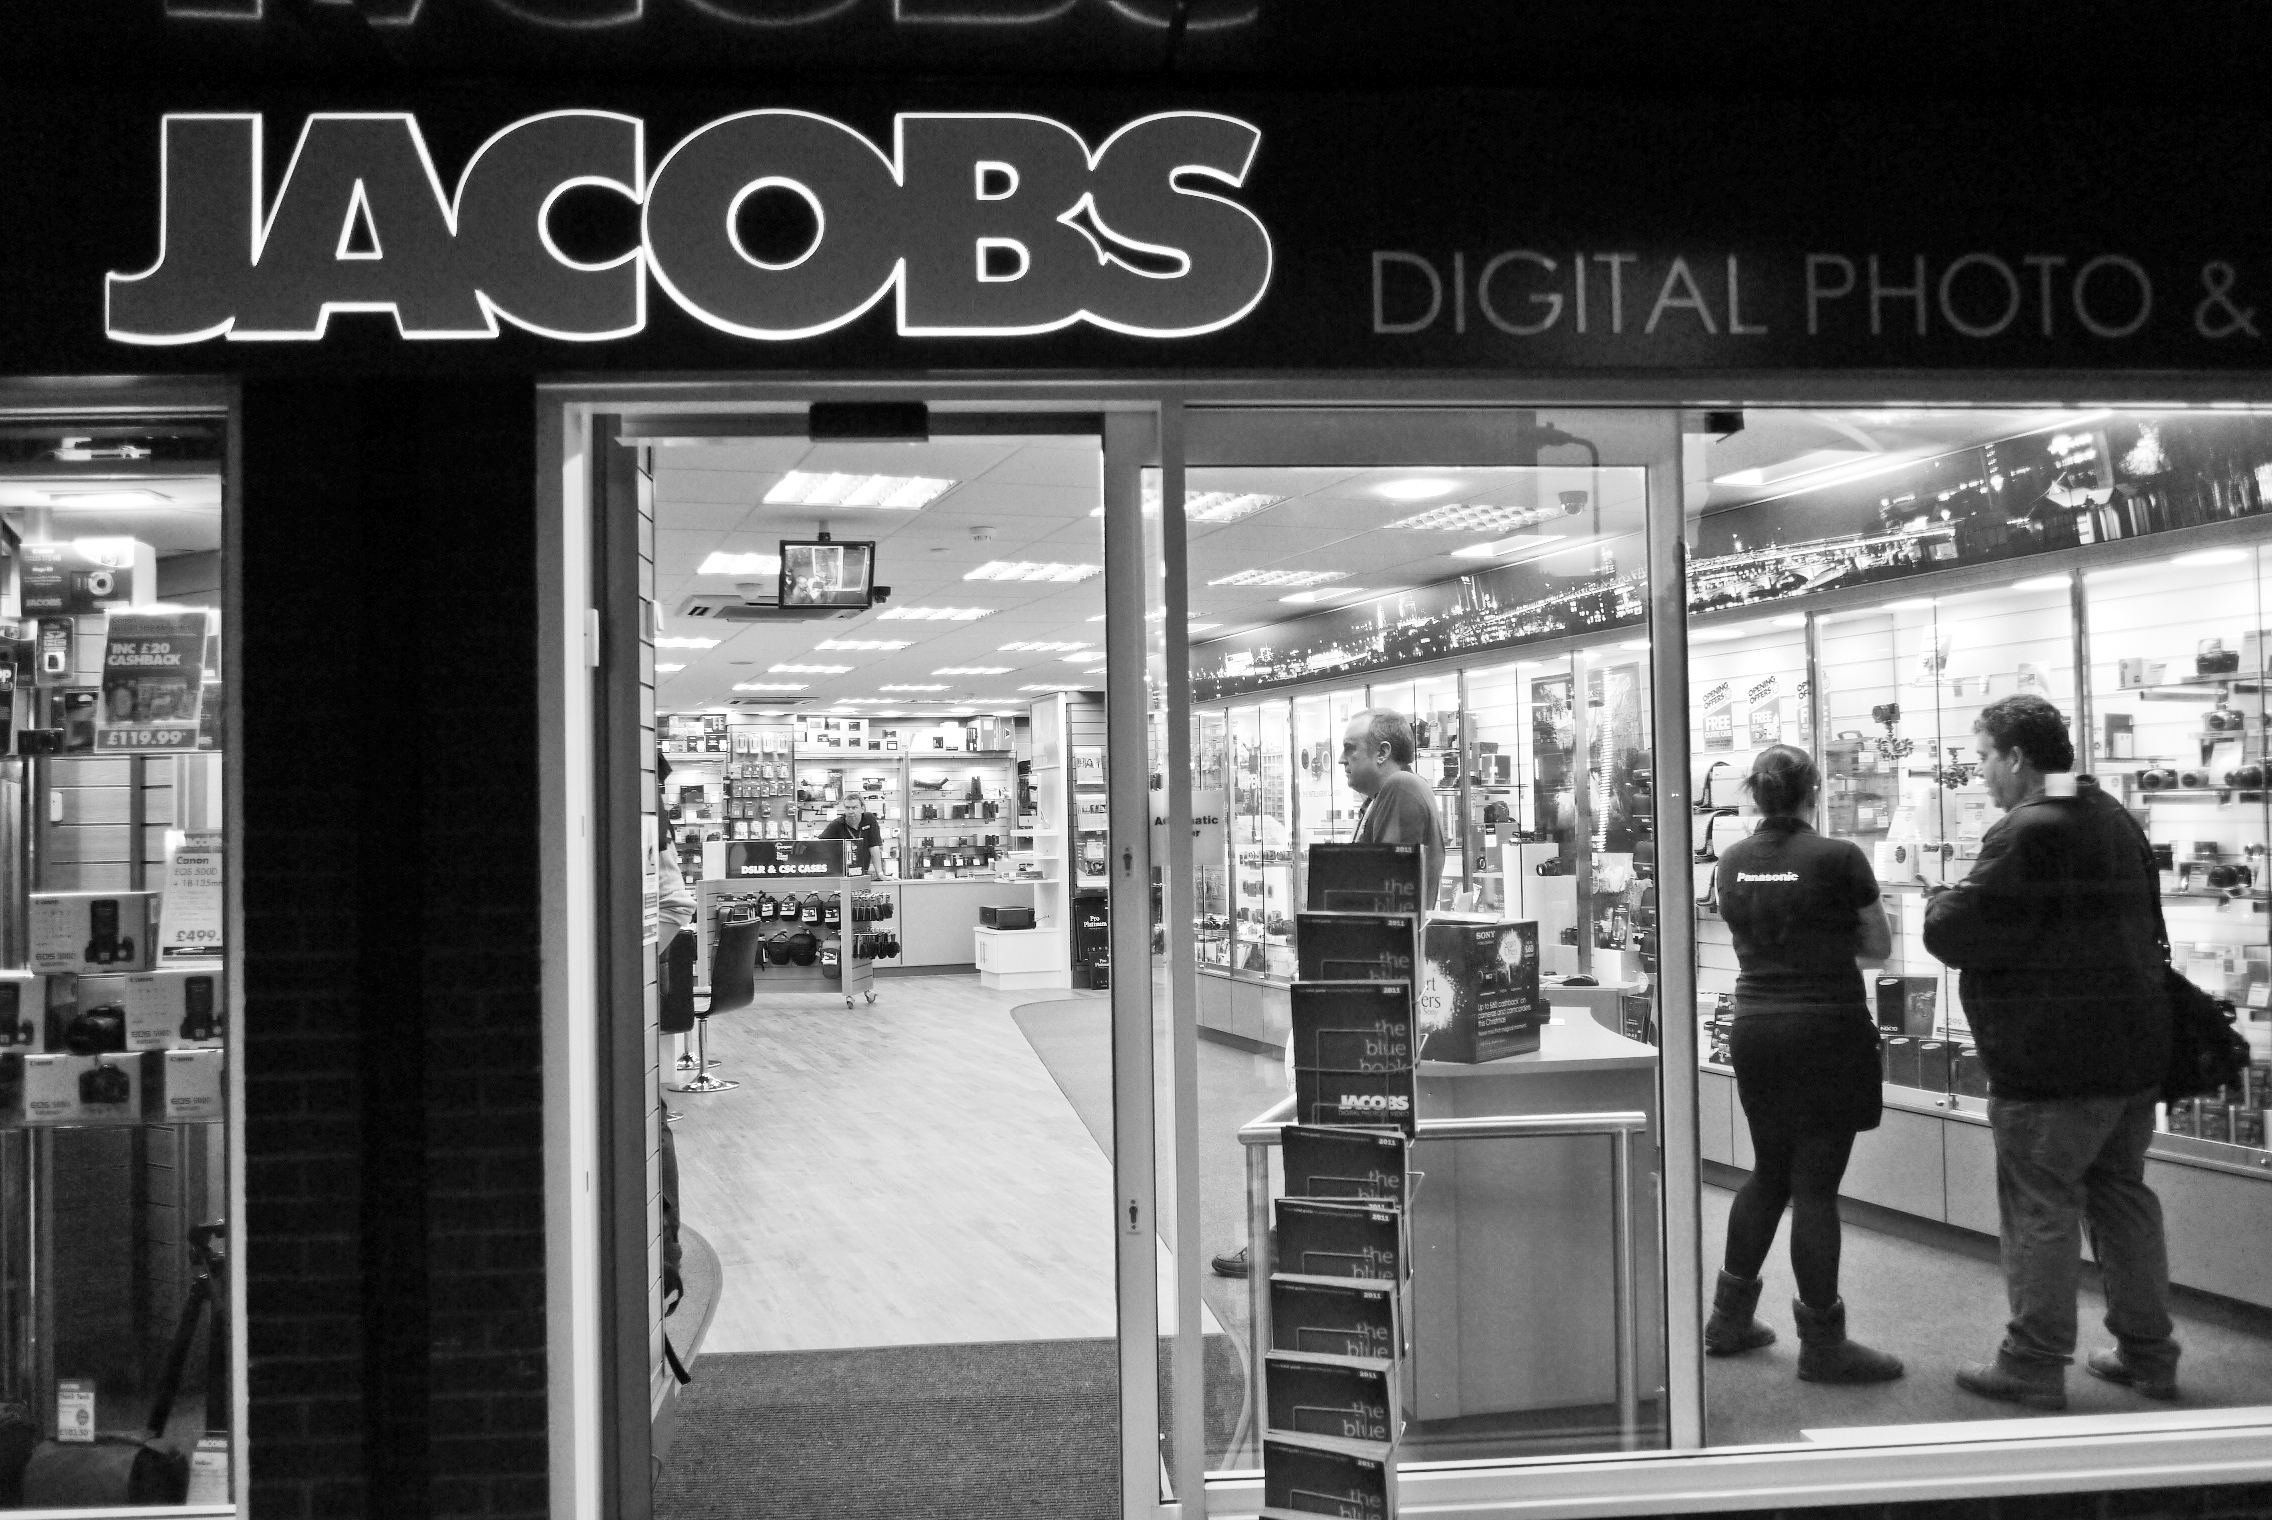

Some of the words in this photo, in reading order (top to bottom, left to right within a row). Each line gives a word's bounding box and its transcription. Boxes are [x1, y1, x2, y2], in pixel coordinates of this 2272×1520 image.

[105, 107, 1273, 344] JACOBS
[1371, 249, 1768, 337] DIGITAL
[1805, 252, 2154, 338] PHOTO
[2193, 260, 2261, 340] &
[110, 643, 136, 654] INC
[140, 642, 170, 654] £20
[108, 654, 181, 666] CASHBACK
[1703, 681, 1729, 703] OPENING
[1748, 675, 1776, 697] OPENING
[1704, 692, 1725, 709] OFFERS
[1749, 686, 1771, 704] OFFERS
[1705, 714, 1732, 731] FREE
[1751, 710, 1773, 725] FREE
[1154, 815, 1219, 826] Aatic
[1394, 845, 1413, 853] 2011
[176, 856, 209, 865] Canon
[741, 865, 765, 875] DSLR
[767, 864, 777, 874] &
[778, 864, 796, 874] CSC
[797, 863, 828, 873] CASES
[174, 867, 192, 876] EOS
[195, 867, 218, 876] 500D
[1736, 871, 1799, 882] Panasonic
[1384, 877, 1415, 896] the
[1387, 919, 1405, 927] 2011
[1476, 930, 1496, 940] SONY
[1379, 951, 1410, 968] the
[1383, 986, 1401, 995] 2011
[1477, 1003, 1484, 1012] Up
[1374, 1019, 1406, 1037] the
[1366, 1038, 1407, 1056] blue
[1338, 1094, 1410, 1112] JACOBS
[1378, 1138, 1397, 1147] 2011
[1369, 1169, 1400, 1188] the
[1372, 1213, 1390, 1222] 2011
[1362, 1245, 1393, 1264] the
[1363, 1292, 1382, 1300] 2011
[1357, 1321, 1388, 1340] the
[1346, 1339, 1388, 1359] blue
[1359, 1370, 1378, 1380] 2011
[1352, 1400, 1384, 1419] the
[1343, 1418, 1386, 1440] blue
[1357, 1459, 1375, 1468] 2011
[1350, 1488, 1382, 1508] the
